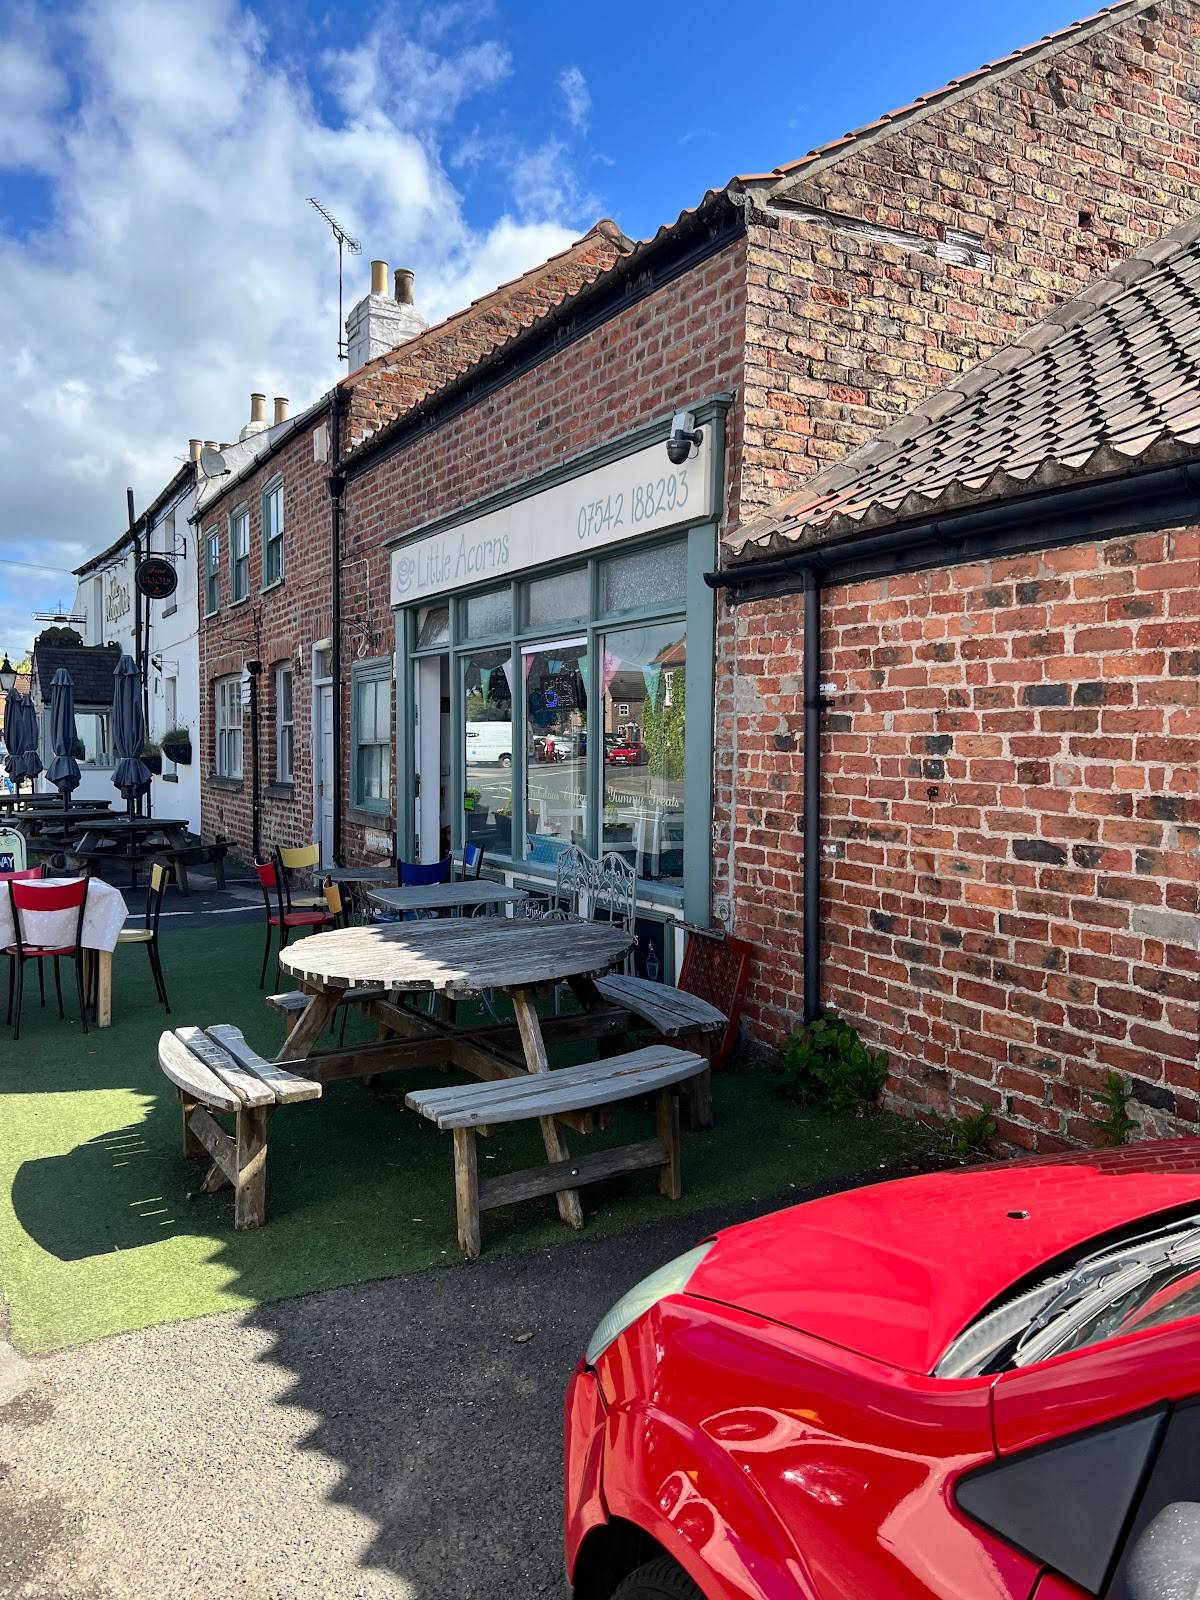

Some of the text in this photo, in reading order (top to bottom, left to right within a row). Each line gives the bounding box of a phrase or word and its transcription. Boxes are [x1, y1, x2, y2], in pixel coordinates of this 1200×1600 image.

[577, 469, 689, 540] 07542 188293
[417, 533, 510, 589] Little Acorns
[607, 785, 680, 808] Yummy Treats
